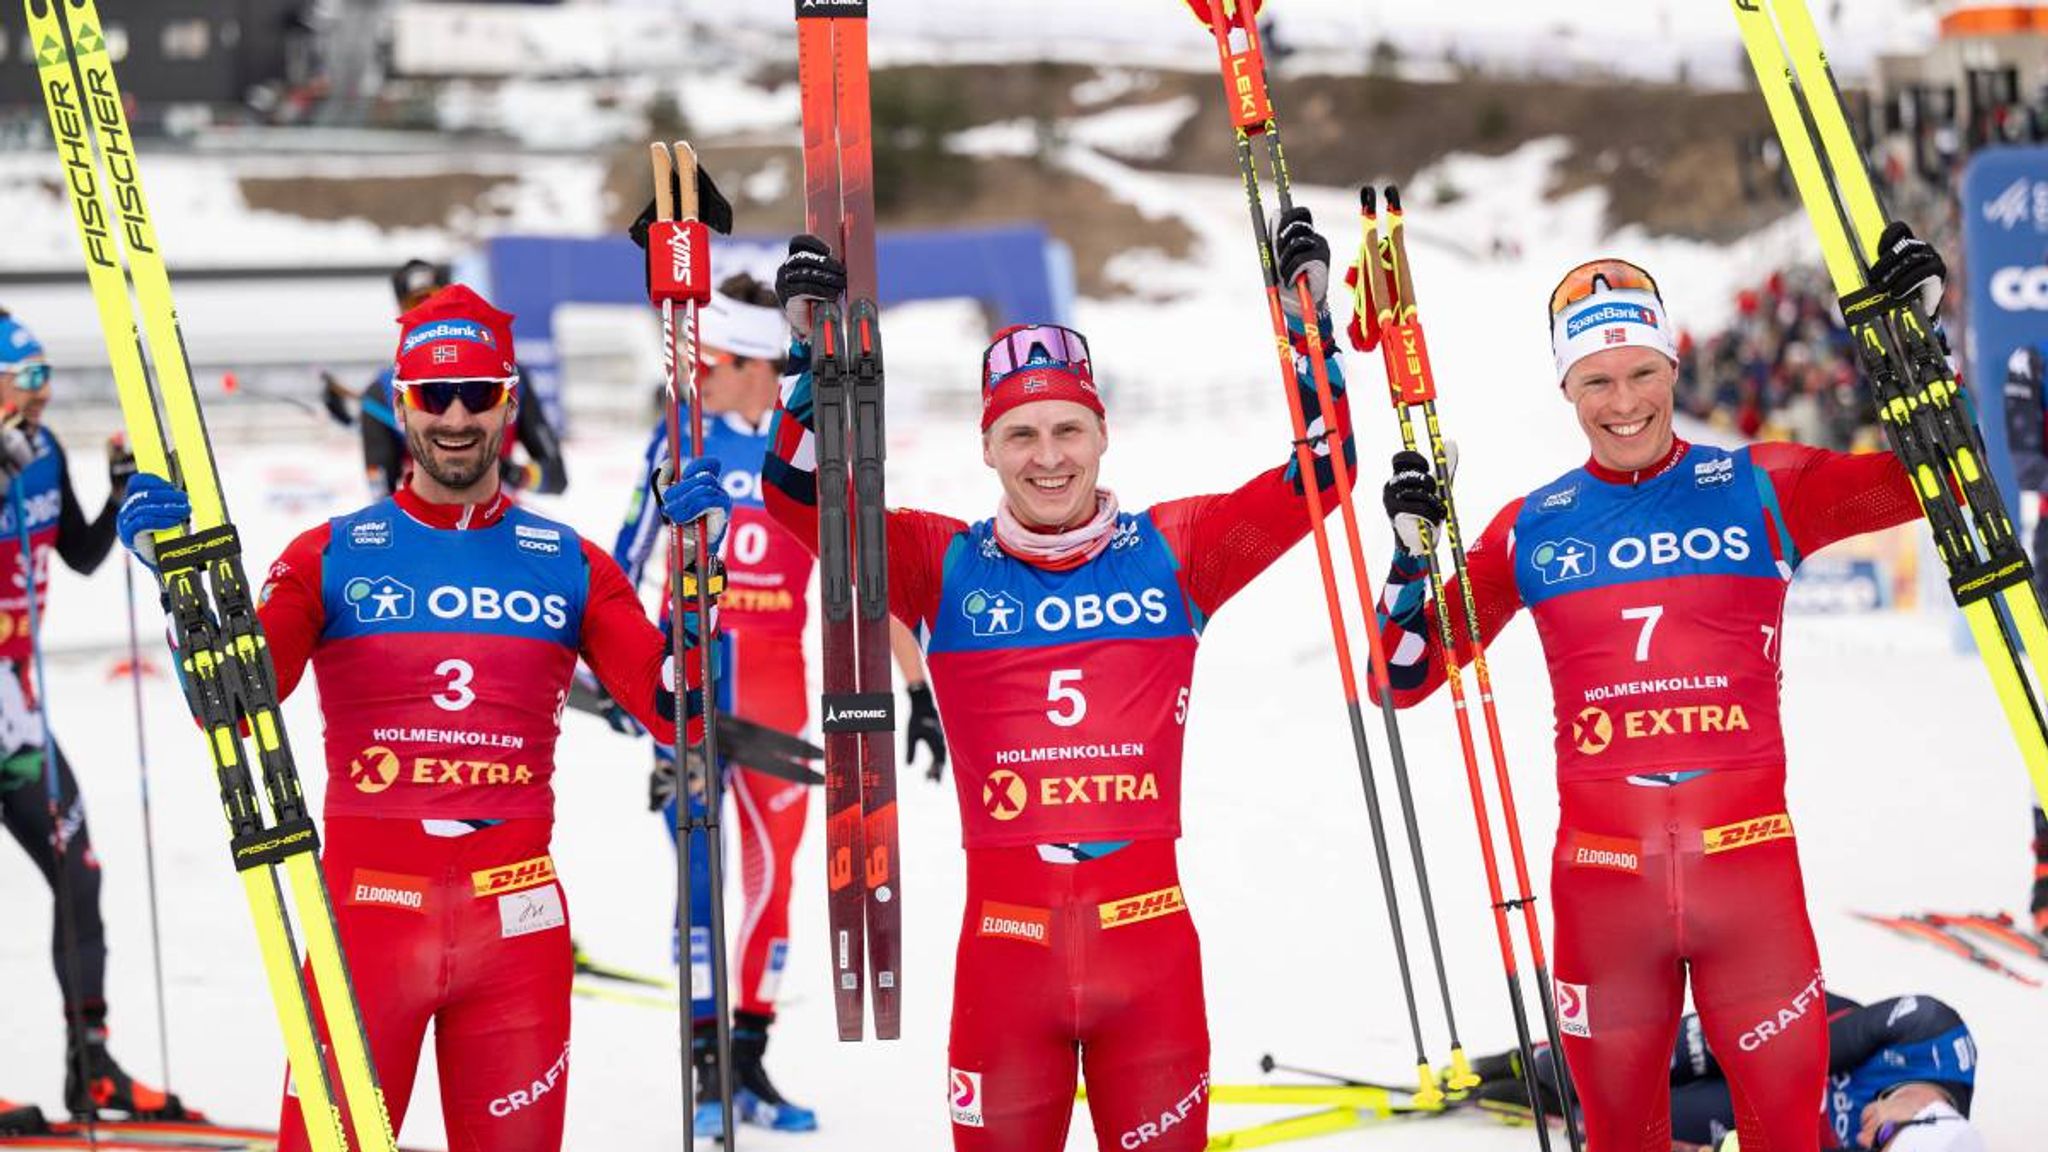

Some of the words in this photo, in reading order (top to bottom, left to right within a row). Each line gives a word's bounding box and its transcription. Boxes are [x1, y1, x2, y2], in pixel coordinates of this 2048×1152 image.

[1232, 58, 1257, 118] LEKI
[48, 79, 115, 267] FISCHER
[87, 68, 153, 254] FISCHER
[1568, 307, 1640, 333] SpareBank
[1401, 328, 1426, 395] LEKI
[518, 539, 559, 553] coop
[1608, 526, 1750, 569] OBOS
[428, 585, 567, 629] OBOS
[1035, 588, 1167, 631] OBOS
[1621, 605, 1664, 662] 7
[1760, 624, 1775, 660] 7
[432, 658, 476, 711] 3
[1046, 669, 1087, 727] 5
[1584, 676, 1729, 701] HOLMENKOLLEN
[838, 709, 887, 719] ATOMIC
[1174, 687, 1190, 725] 5
[1624, 705, 1750, 739] EXTRA
[374, 728, 524, 749] HOLMENKOLLEN
[996, 743, 1144, 764] HOLMENKOLLEN
[412, 757, 533, 785] EXTRA
[1040, 773, 1159, 805] EXTRA
[1719, 819, 1786, 848] DHL
[489, 861, 552, 889] DHL
[1577, 848, 1638, 869] ELDORADO
[355, 884, 423, 908] ELDORADO
[1114, 892, 1179, 922] DHL
[982, 917, 1044, 940] ELDORADO
[1738, 981, 1821, 1052] CRAFT
[489, 1051, 565, 1117] CRAFT
[1120, 1085, 1201, 1150] CRAFT
